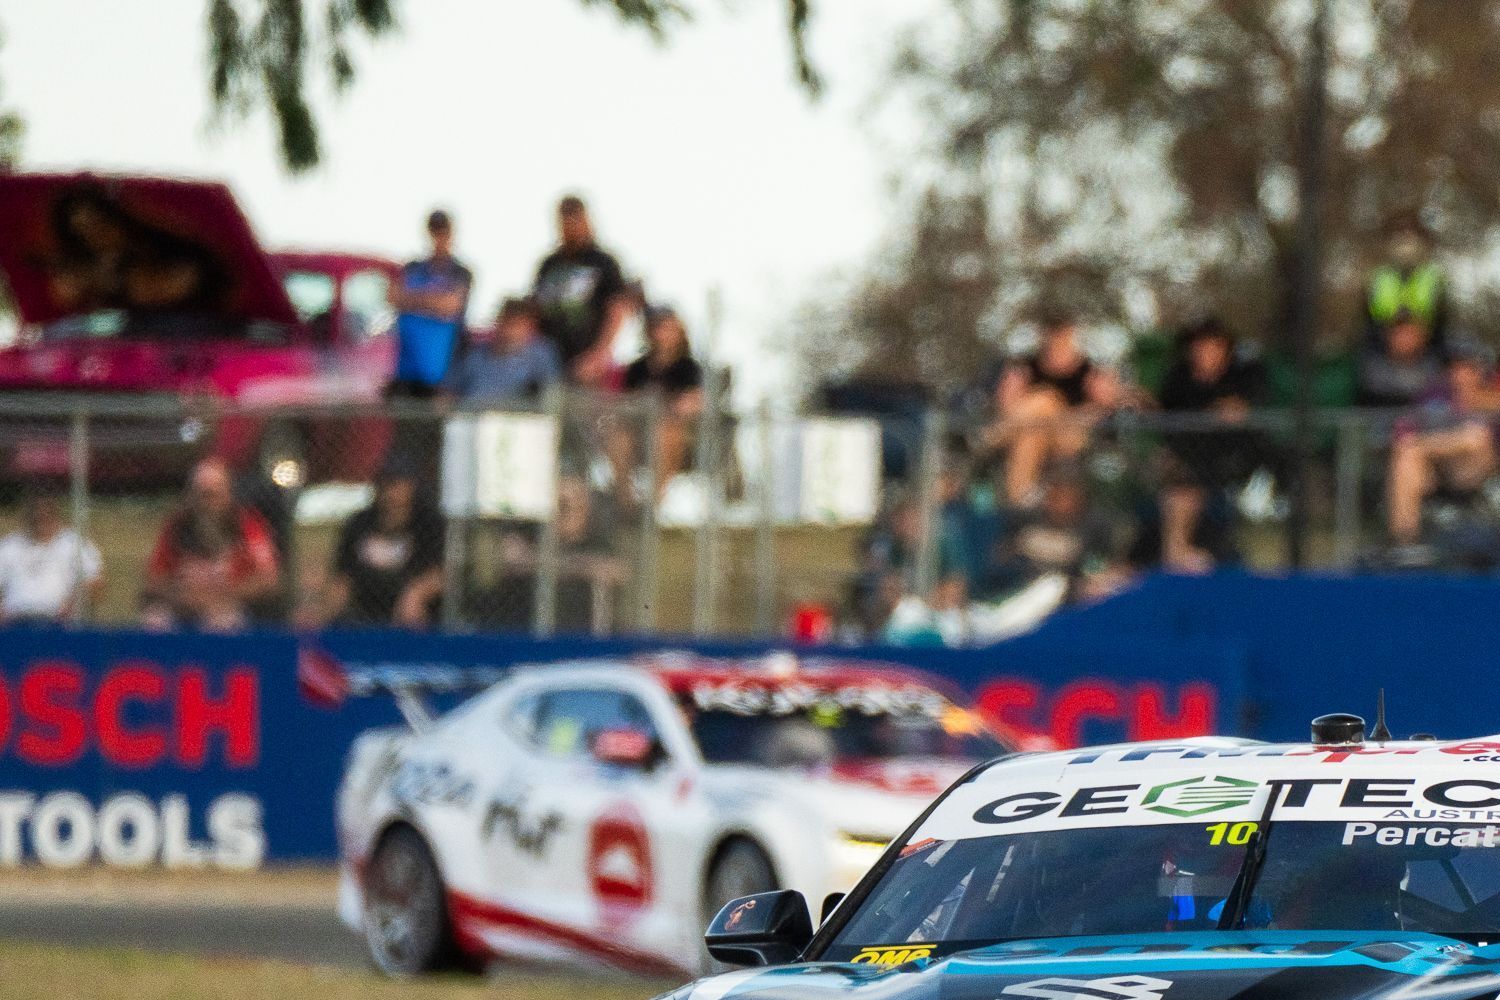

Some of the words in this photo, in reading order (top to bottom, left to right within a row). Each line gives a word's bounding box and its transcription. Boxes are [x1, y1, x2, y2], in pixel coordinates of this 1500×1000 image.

[0, 662, 258, 767] SCH
[1206, 822, 1258, 846] 10
[1342, 822, 1500, 848] Percat
